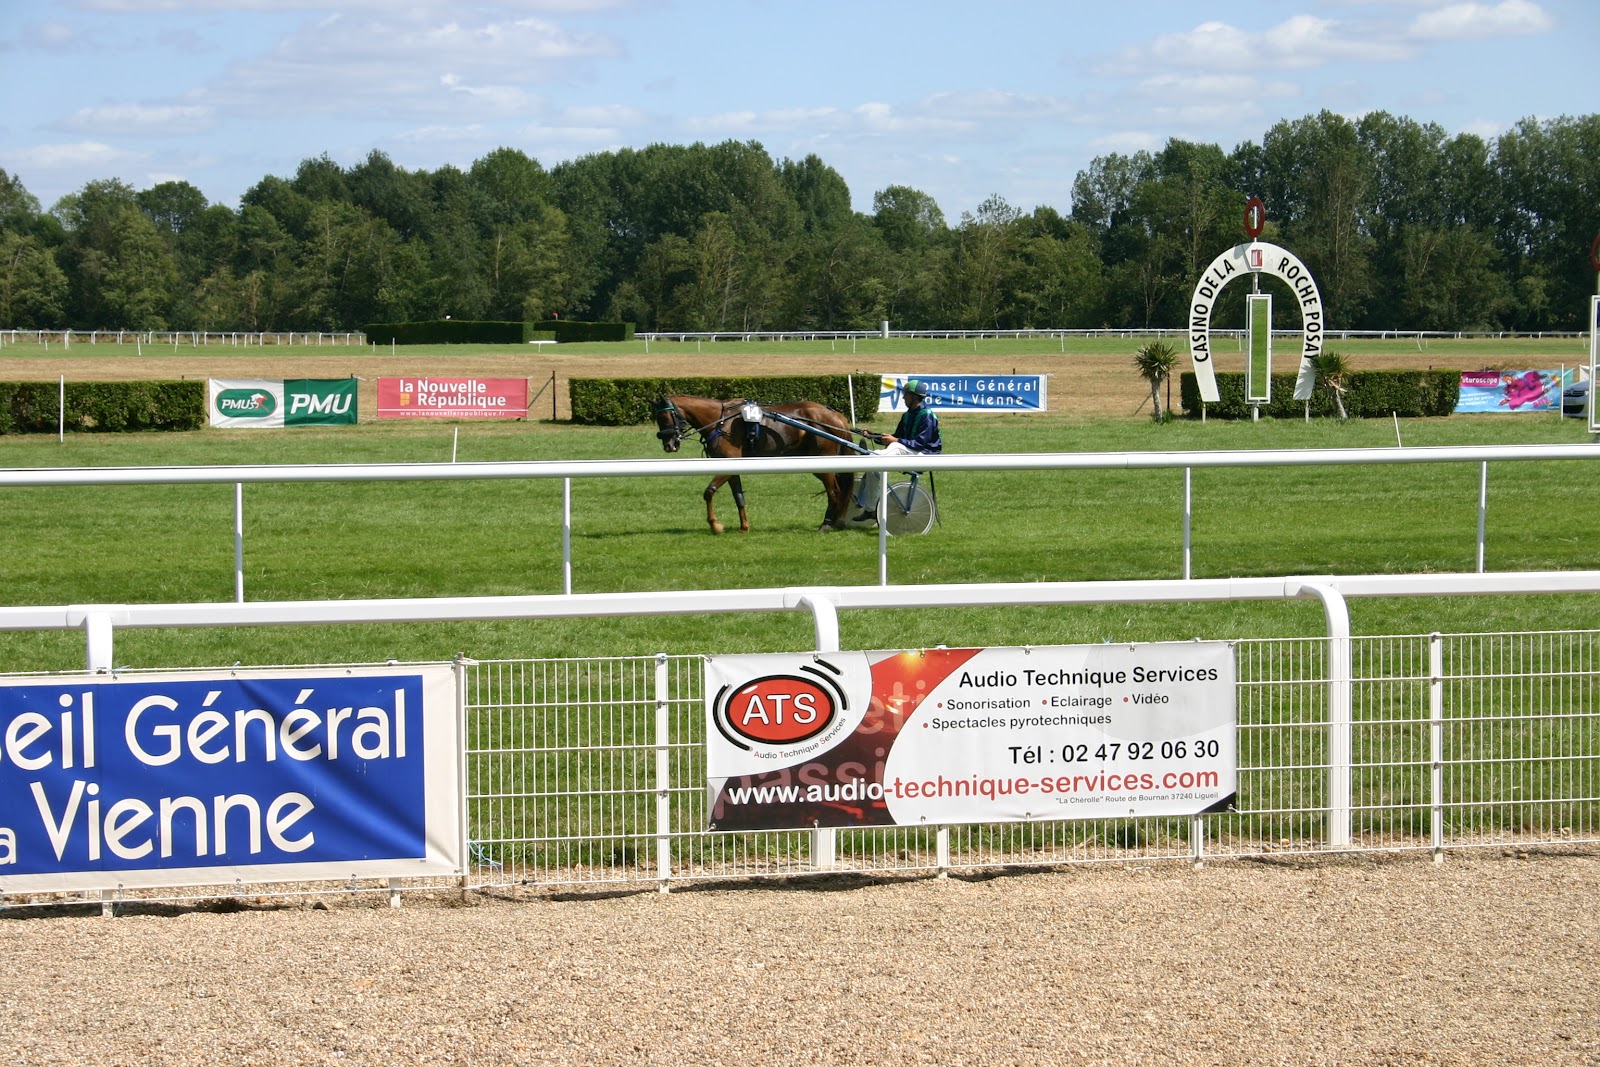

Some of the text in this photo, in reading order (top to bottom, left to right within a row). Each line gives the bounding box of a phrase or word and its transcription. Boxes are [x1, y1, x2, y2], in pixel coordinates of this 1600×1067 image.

[1213, 259, 1235, 280] LA
[1199, 276, 1219, 299] DE
[1192, 304, 1209, 362] CASINO
[400, 380, 486, 393] la Nouvelle
[922, 380, 1036, 391] onseil Général
[221, 399, 250, 409] PMU
[290, 393, 352, 414] PMU
[418, 393, 506, 408] République
[925, 394, 1023, 405] de la Vienne
[744, 405, 761, 420] 14
[959, 666, 1218, 688] Audio Technique Services
[742, 693, 817, 726] ATS
[947, 693, 1169, 711] Sonorisation Eclairage Vidéo
[125, 688, 407, 766] Général
[932, 714, 1112, 730] Spectacles pyrotechniques
[754, 718, 846, 759] Audio Technique Services
[1008, 746, 1042, 764] Tél
[1062, 745, 1088, 762] 02
[1095, 743, 1121, 761] 47
[1128, 742, 1154, 760] 92
[1160, 741, 1187, 759] 06
[1194, 740, 1220, 758] 30
[729, 769, 1219, 806] www.audio-technique-services.com
[1138, 794, 1169, 802] Bournan
[1194, 792, 1218, 800] Ligueil
[30, 780, 315, 862] Vienne
